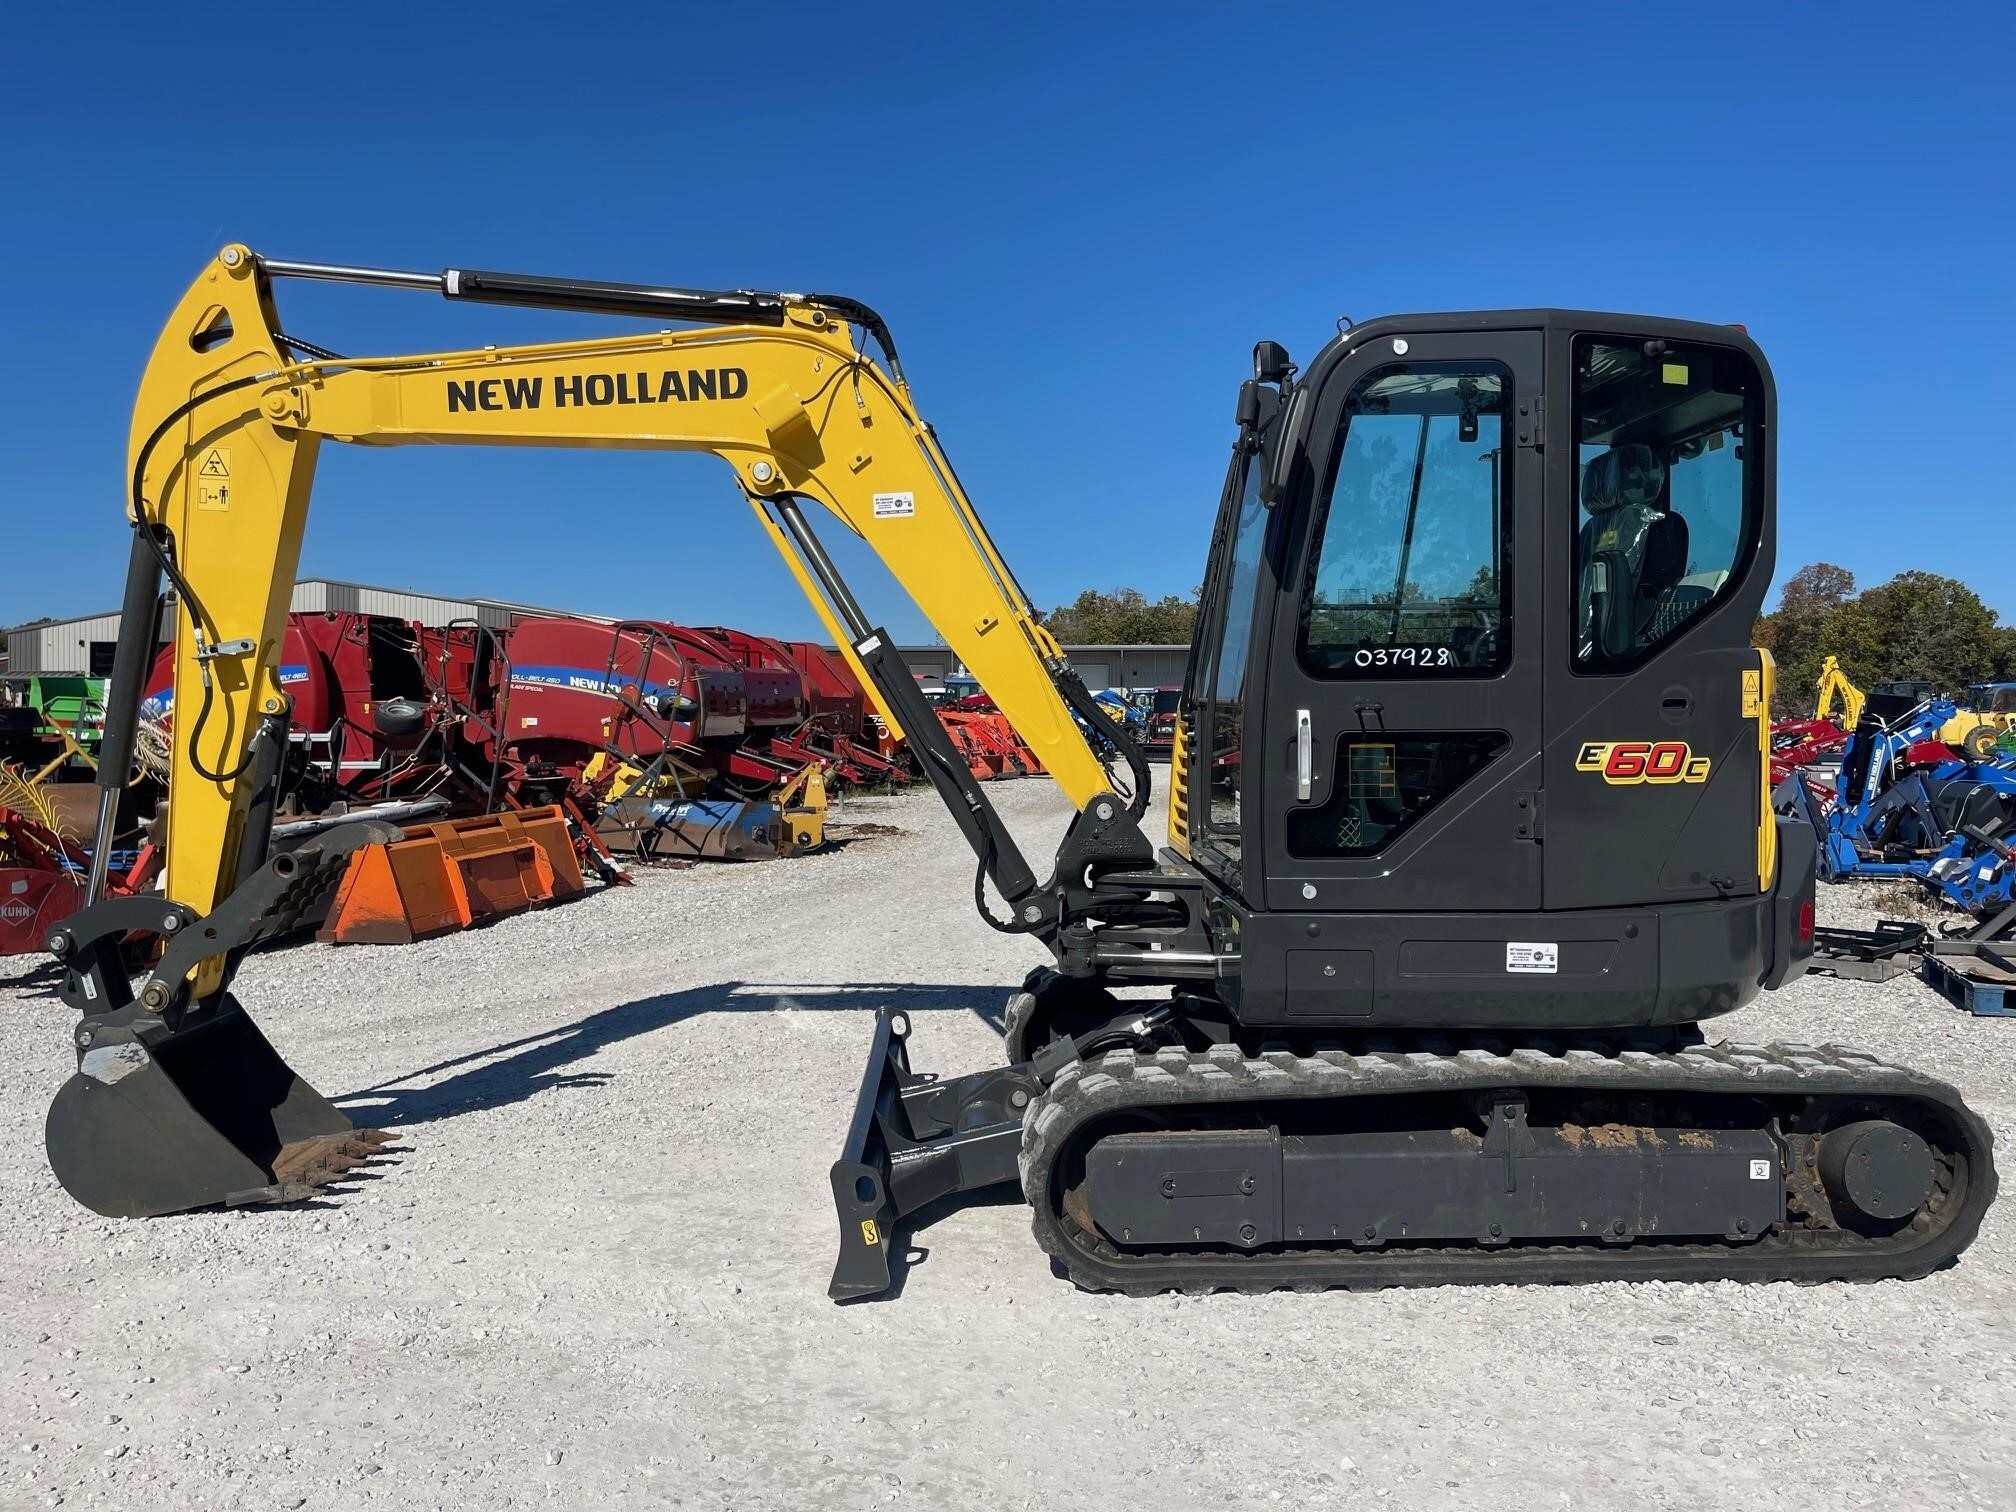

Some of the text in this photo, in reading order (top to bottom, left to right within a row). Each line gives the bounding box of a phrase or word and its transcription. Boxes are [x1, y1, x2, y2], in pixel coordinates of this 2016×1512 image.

[447, 367, 748, 413] NEW HOLLAND
[1354, 647, 1450, 667] 037928
[569, 676, 600, 691] NEW
[1577, 743, 1709, 781] E60C
[1867, 748, 1882, 791] NEW HOLLAND
[1, 906, 30, 917] KUHN
